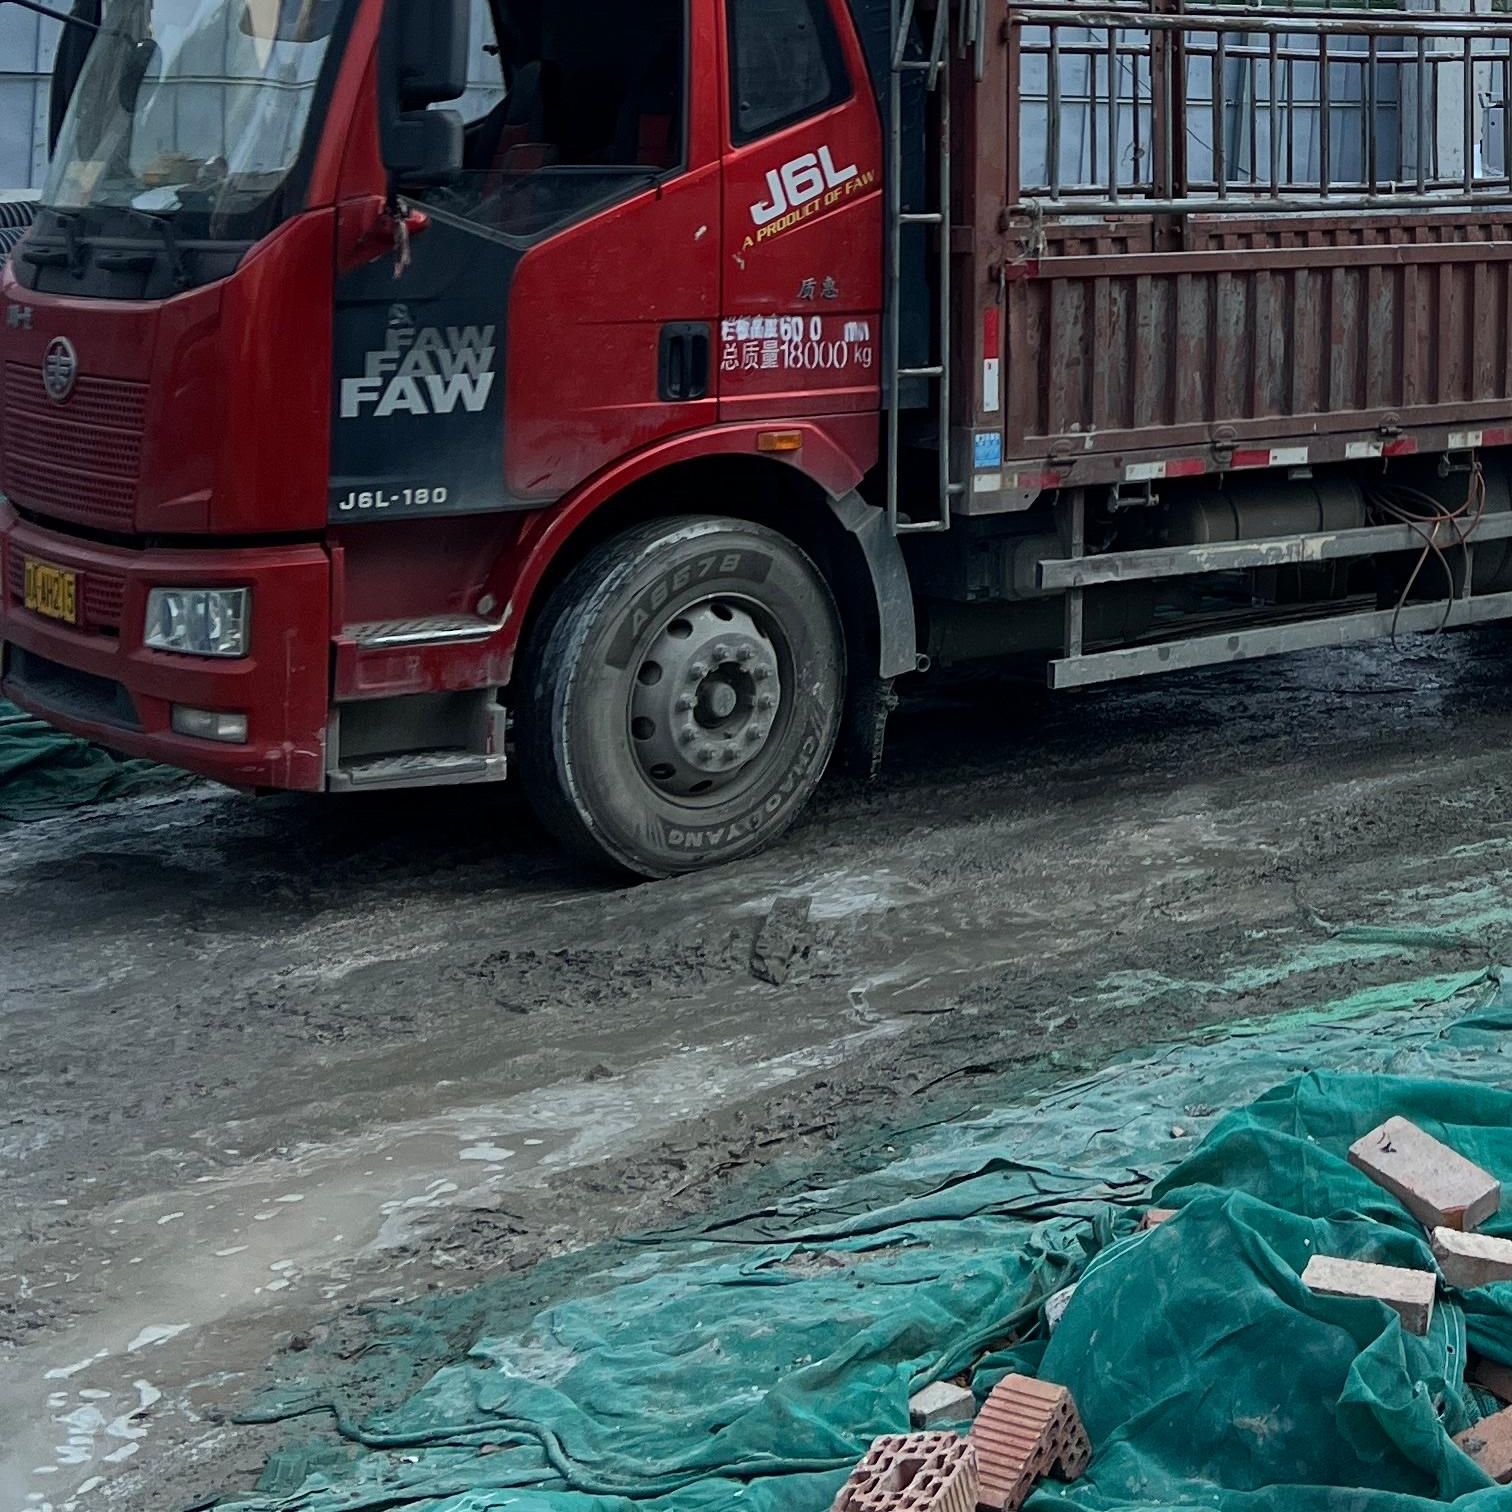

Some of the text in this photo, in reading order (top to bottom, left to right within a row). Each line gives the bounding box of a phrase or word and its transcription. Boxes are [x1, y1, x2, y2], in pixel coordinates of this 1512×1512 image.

[750, 145, 858, 225] J6L
[741, 169, 876, 251] A PRODUCT OF FAW
[365, 346, 497, 381] FAW
[340, 371, 496, 418] FAW
[339, 487, 448, 510] J6L-180
